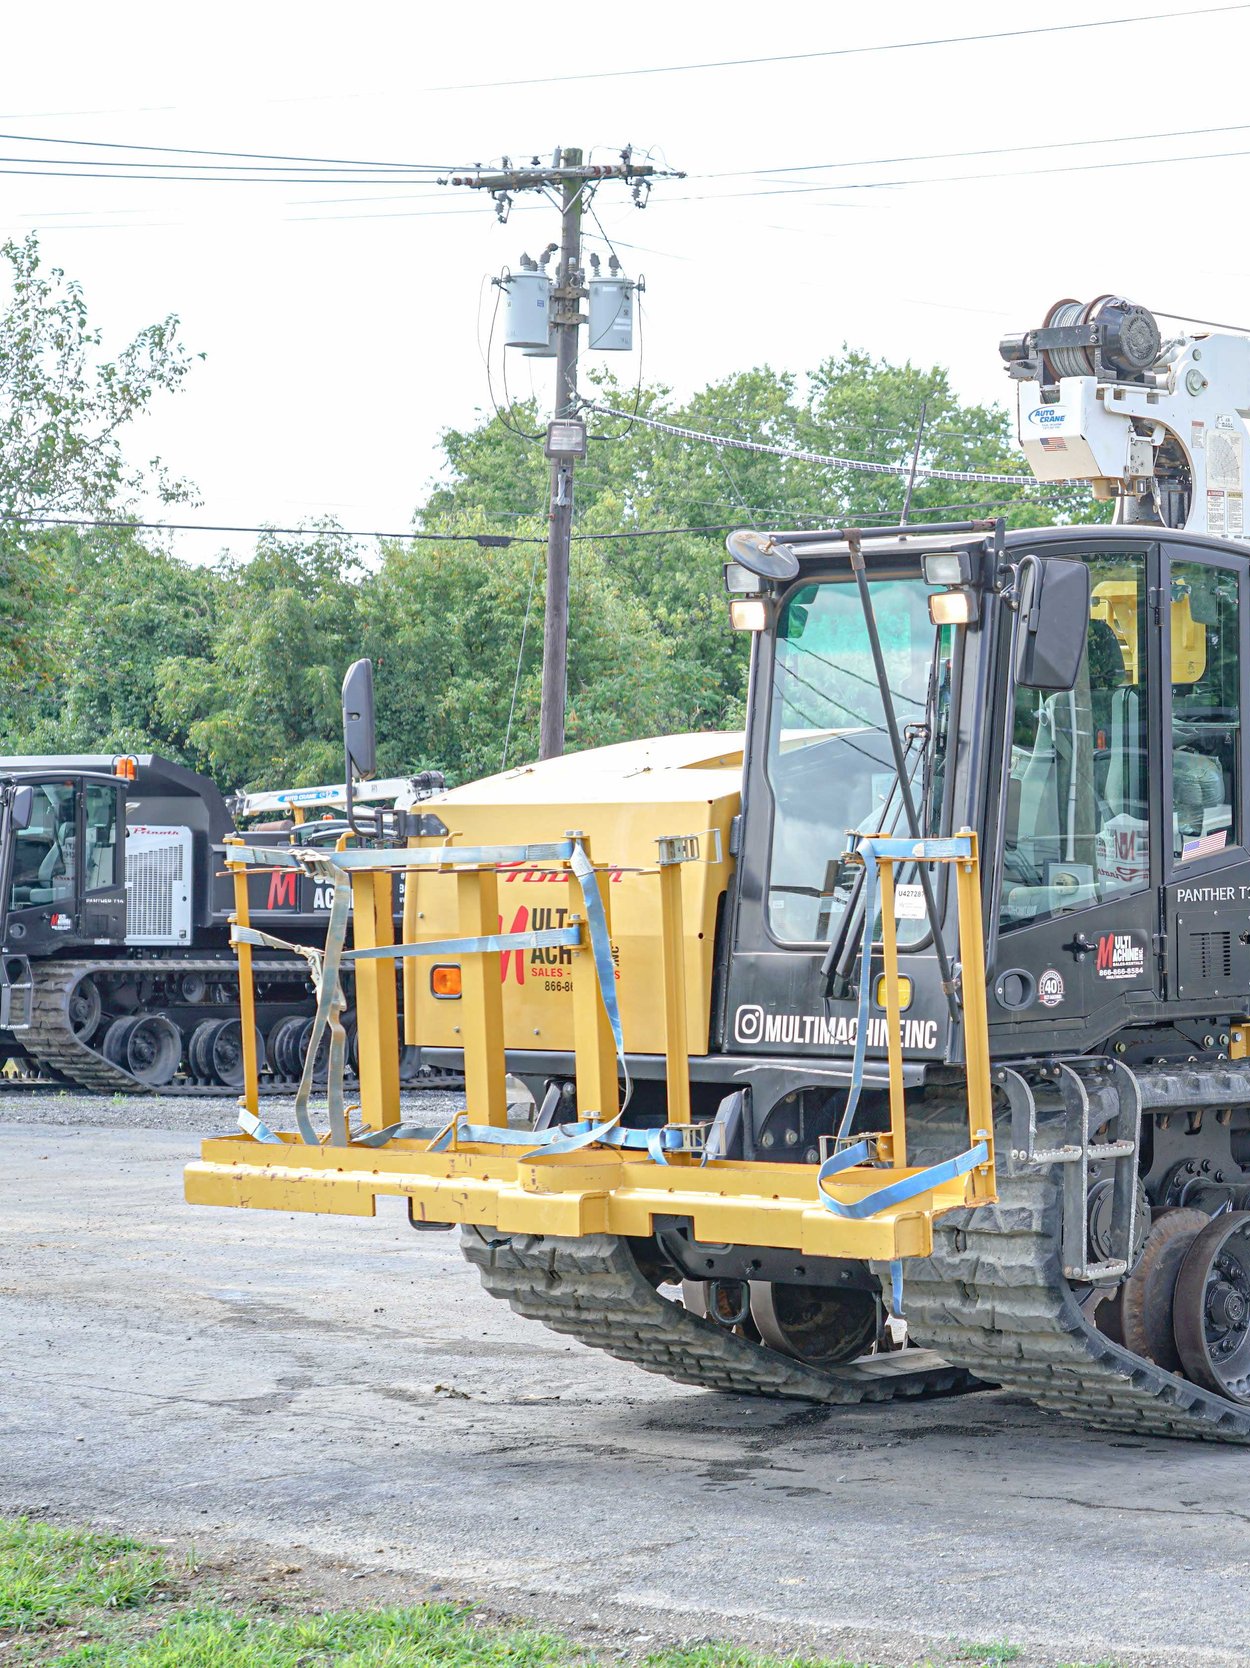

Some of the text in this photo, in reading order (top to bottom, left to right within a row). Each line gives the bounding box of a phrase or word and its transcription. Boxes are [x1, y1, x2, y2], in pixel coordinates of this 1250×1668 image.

[1034, 409, 1055, 417] AUTO
[1039, 415, 1066, 423] CRANE
[1176, 886, 1236, 903] PANTHER
[531, 967, 563, 978] SALES
[1044, 979, 1058, 994] 40
